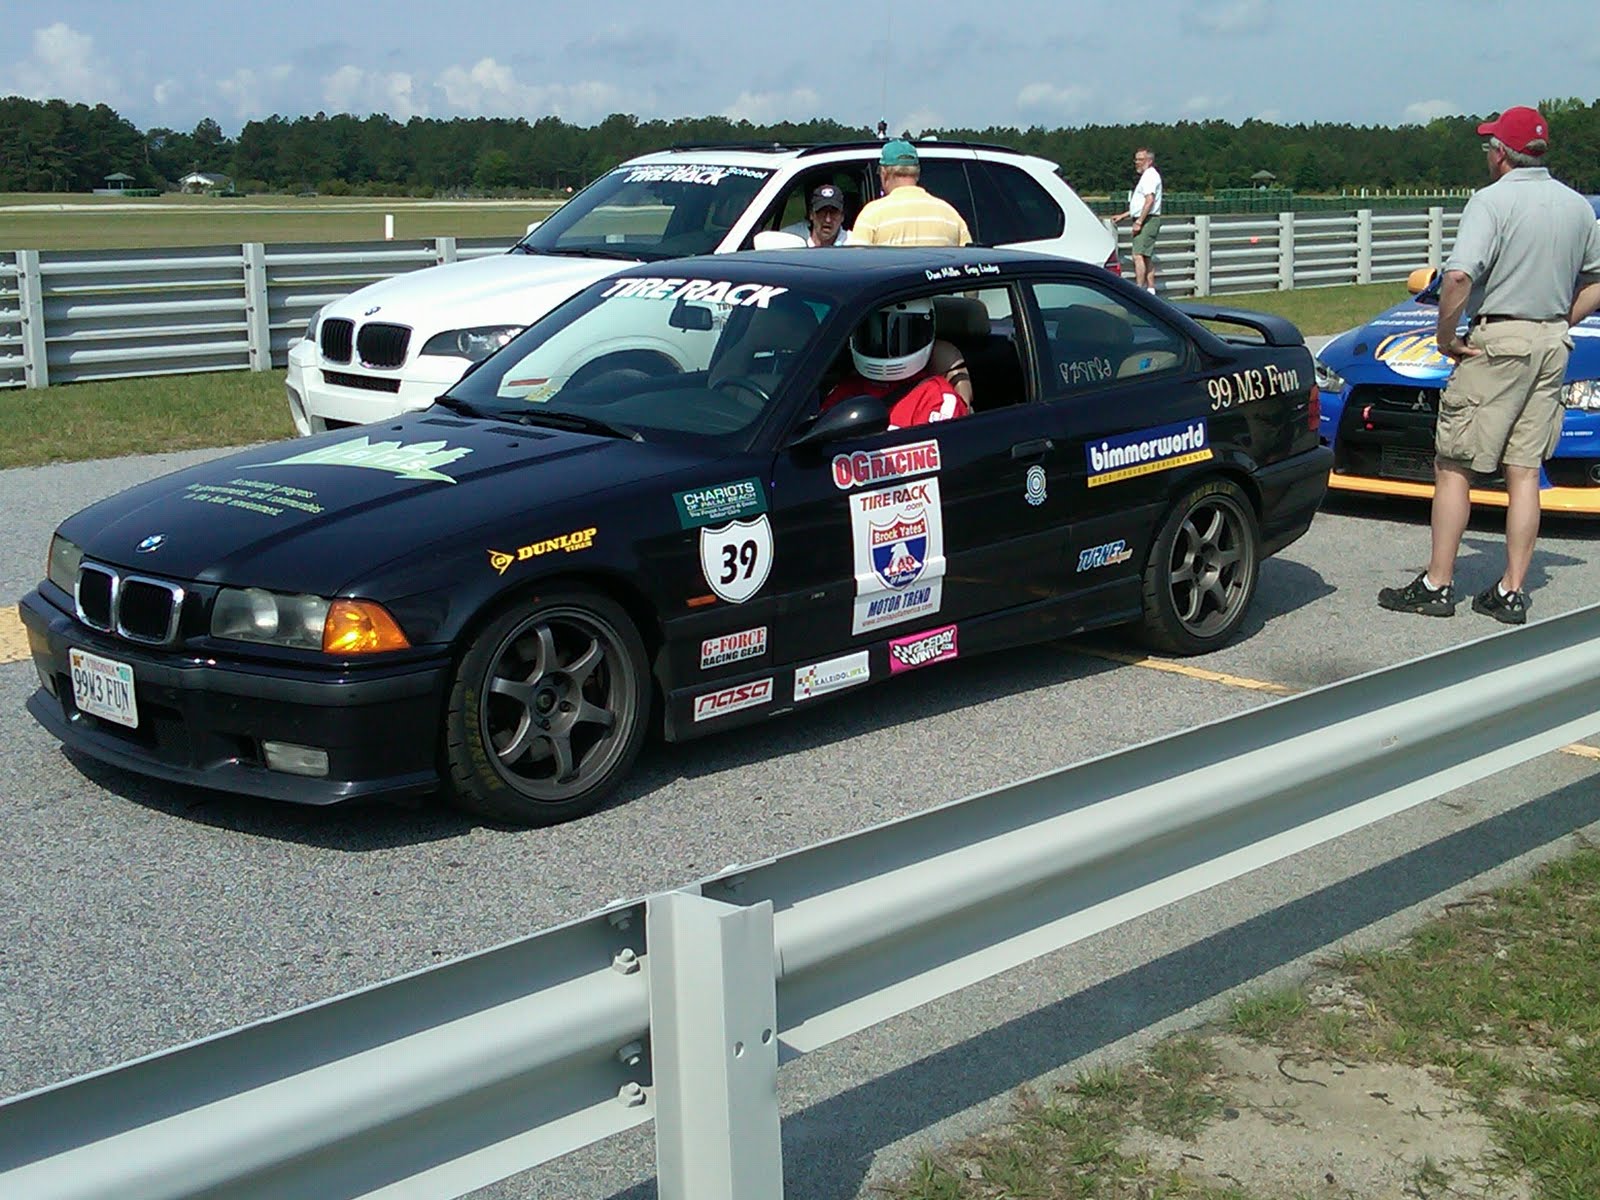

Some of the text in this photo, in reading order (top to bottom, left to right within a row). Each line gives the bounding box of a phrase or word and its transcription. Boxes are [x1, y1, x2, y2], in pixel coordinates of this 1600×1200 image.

[1208, 364, 1300, 411] 99 M3 Fun
[1091, 423, 1204, 472] bimmerworld
[683, 482, 755, 505] CHARIOTS
[904, 502, 924, 512] .com
[518, 527, 597, 560] DUNLOP
[874, 529, 899, 543] Brock
[720, 539, 758, 585] 39
[1076, 539, 1126, 572] TURNER
[867, 587, 931, 618] MOTOR TREND
[702, 644, 765, 667] RACING GEAR
[703, 629, 764, 656] G-FORCE
[105, 677, 130, 711] FUN
